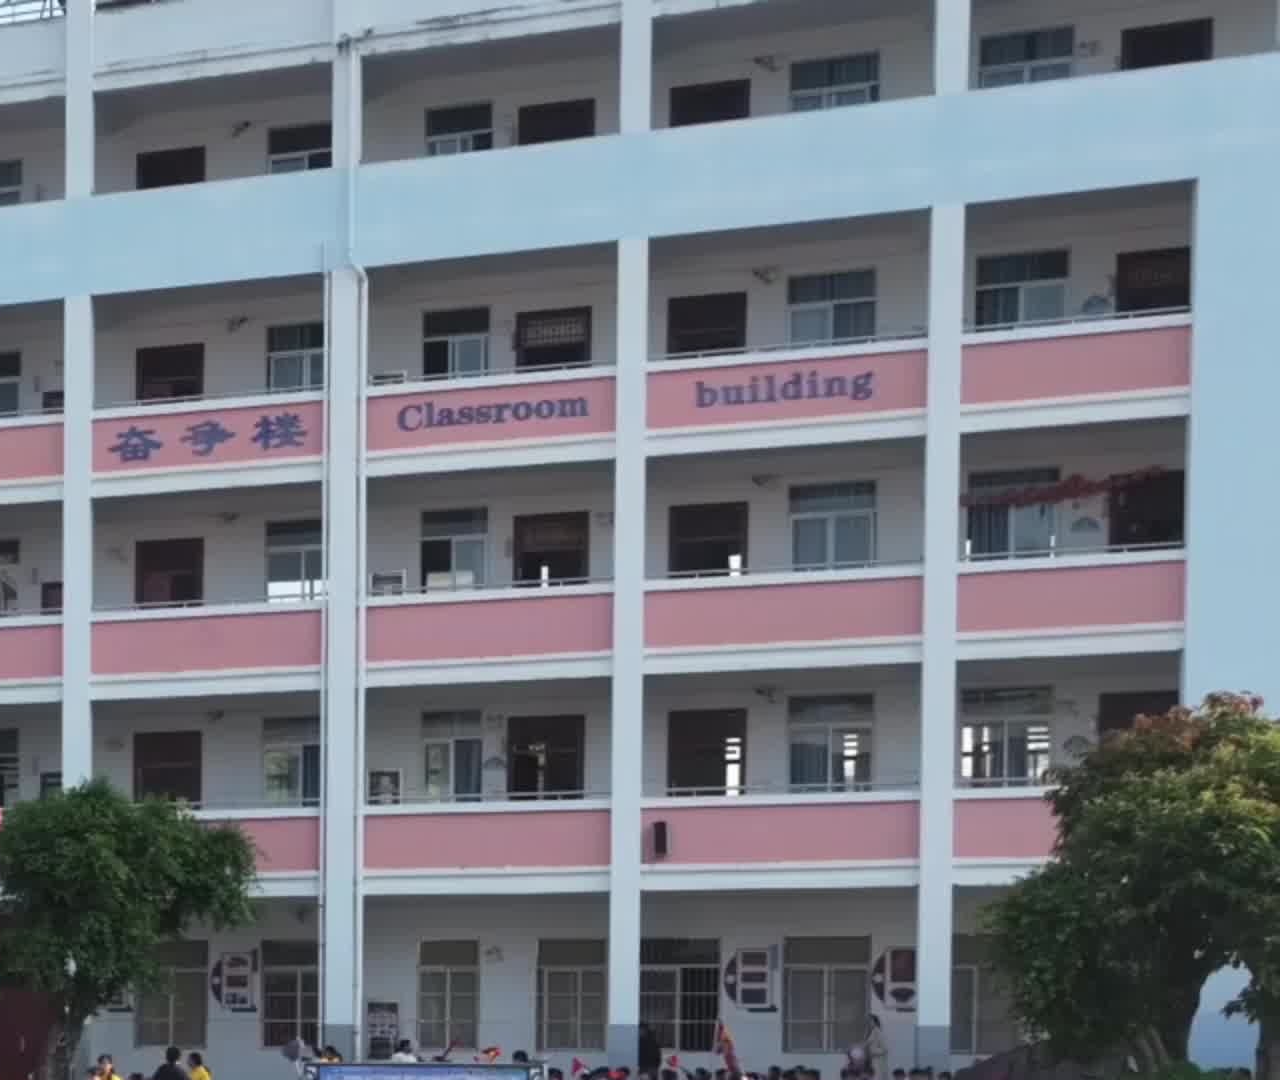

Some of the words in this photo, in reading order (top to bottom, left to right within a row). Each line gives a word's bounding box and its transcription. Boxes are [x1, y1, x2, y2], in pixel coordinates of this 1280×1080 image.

[397, 396, 590, 432] Classroom
[695, 370, 875, 408] building
[108, 412, 308, 463] 奋争楼
